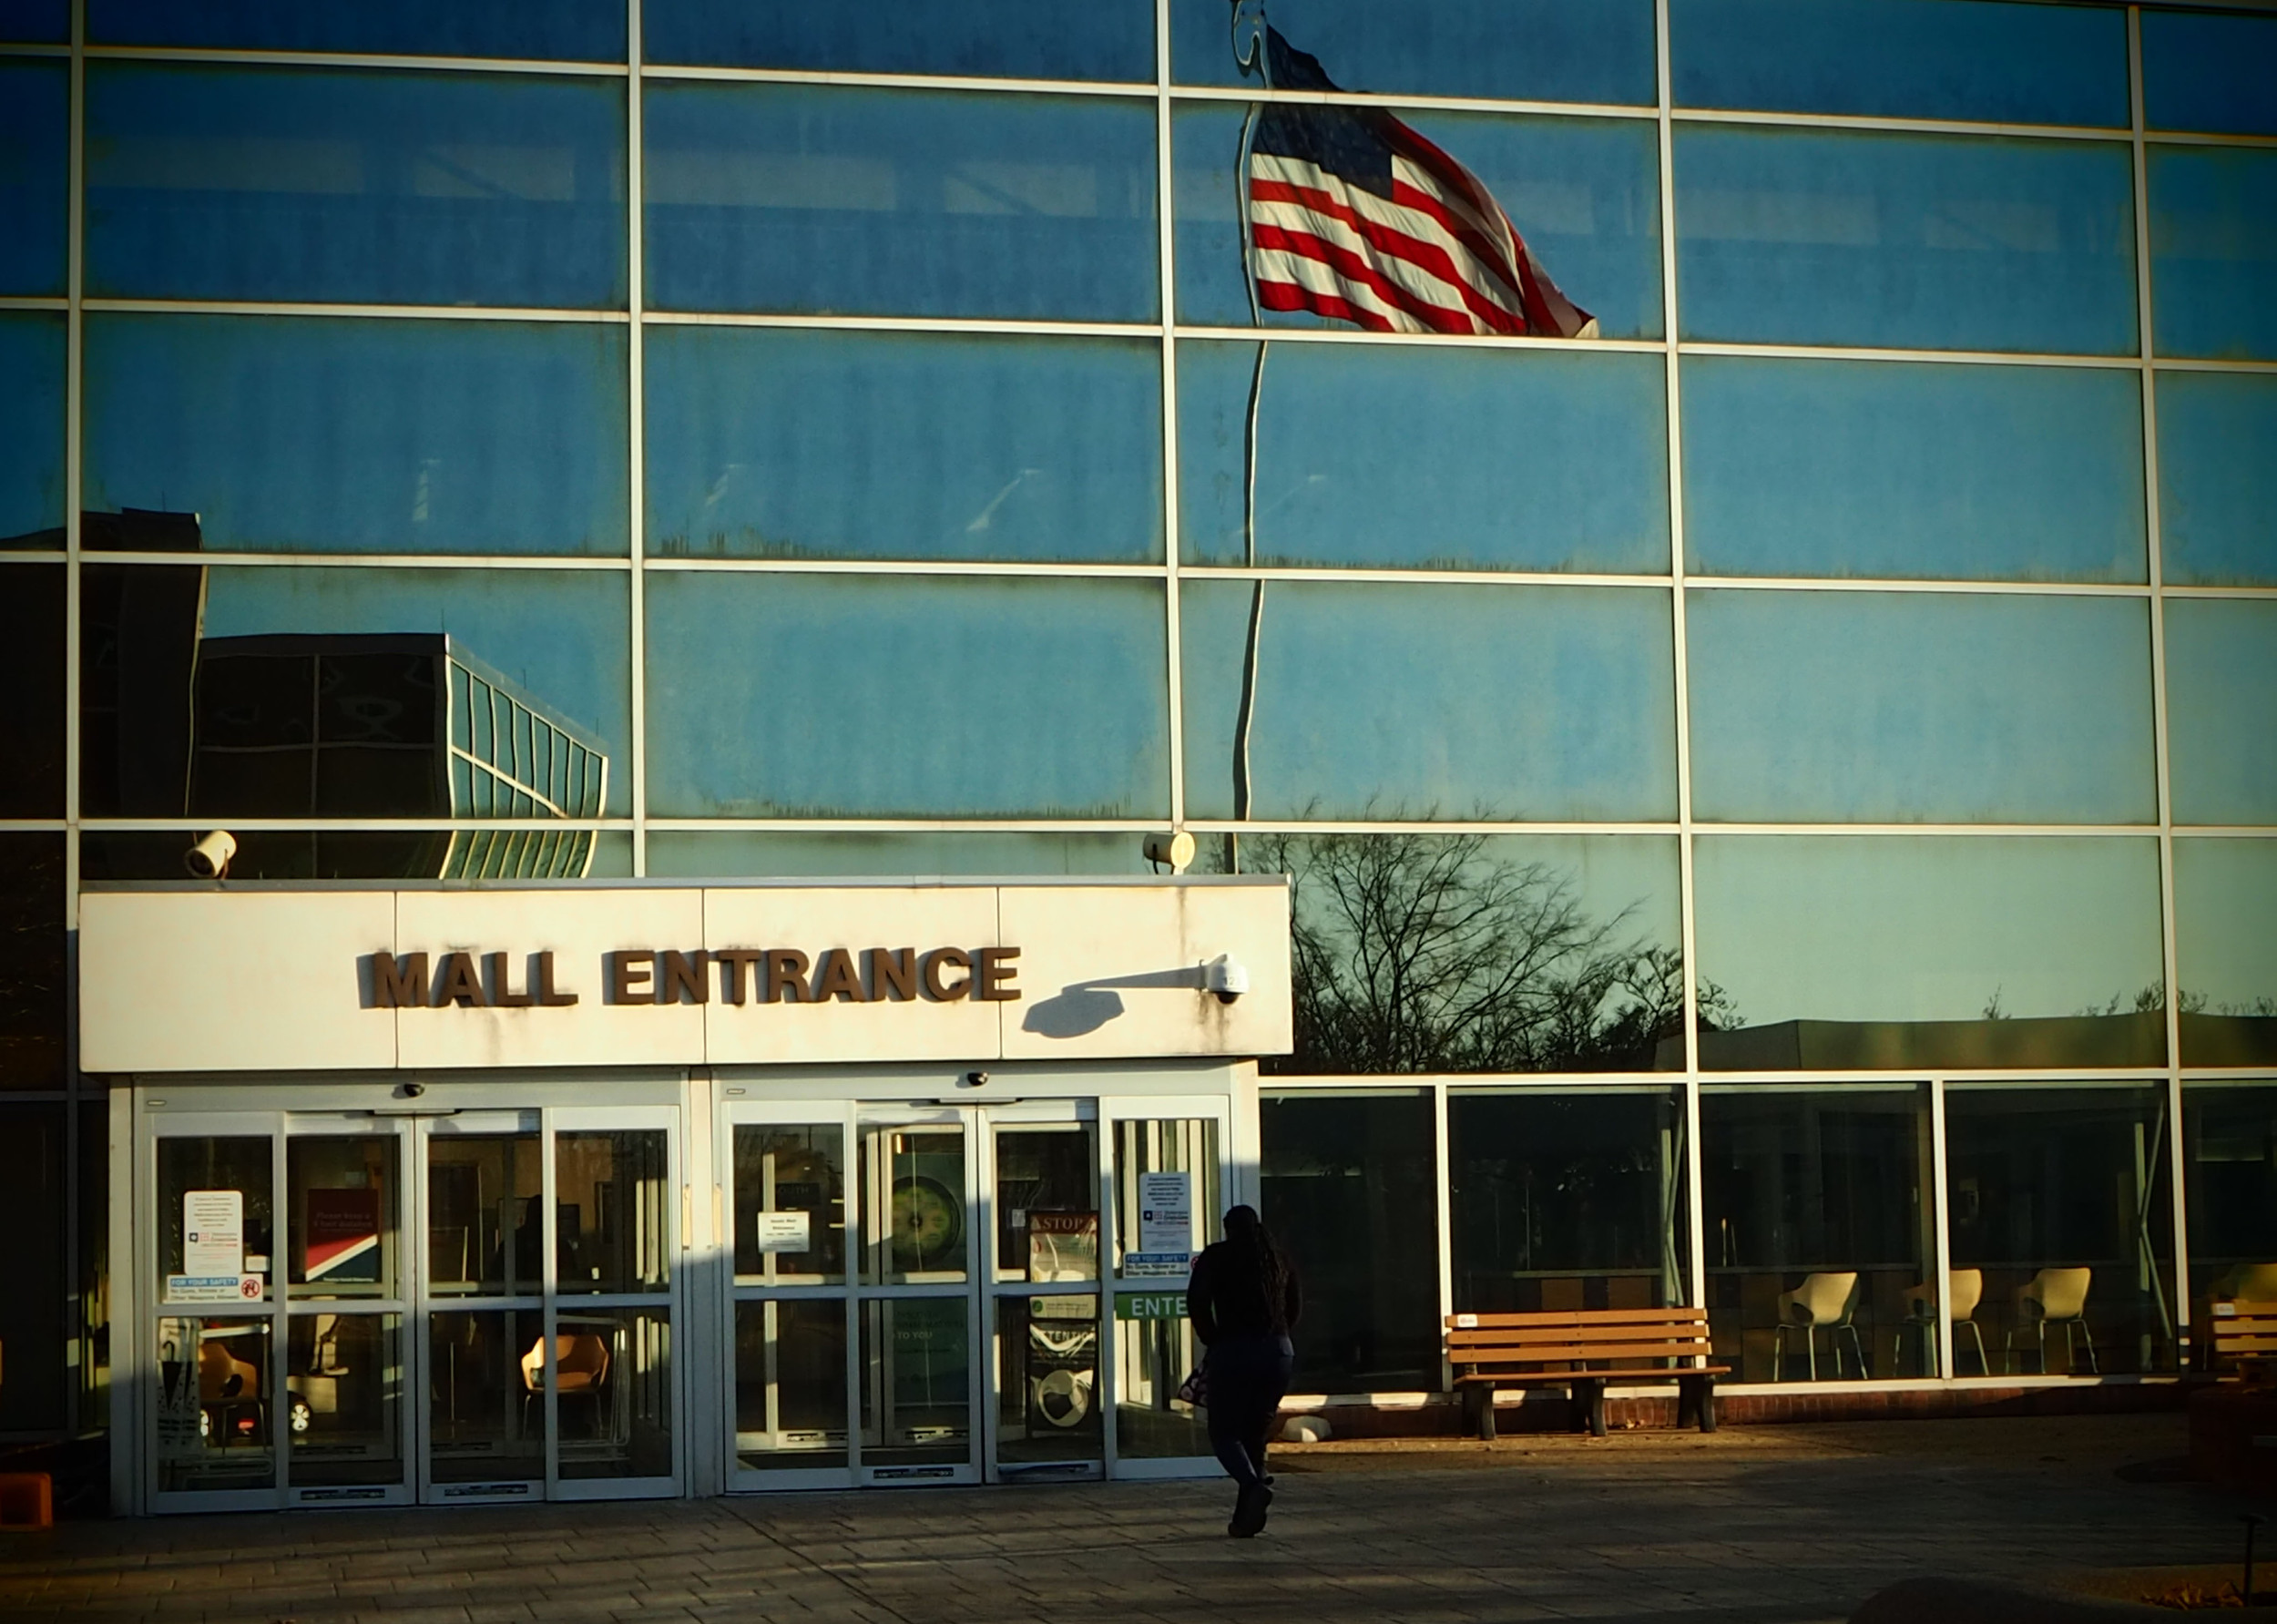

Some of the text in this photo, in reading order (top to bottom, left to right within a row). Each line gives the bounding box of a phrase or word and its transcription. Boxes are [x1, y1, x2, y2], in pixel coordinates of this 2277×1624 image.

[372, 946, 1021, 1008] MALL ENTRANCE
[1043, 1217, 1083, 1231] STOP
[1142, 1254, 1160, 1262] YOUR
[1162, 1254, 1188, 1262] SAFETY
[209, 1278, 238, 1286] SAFETY
[1131, 1297, 1189, 1317] ENTE
[896, 1331, 934, 1341] TO YOU
